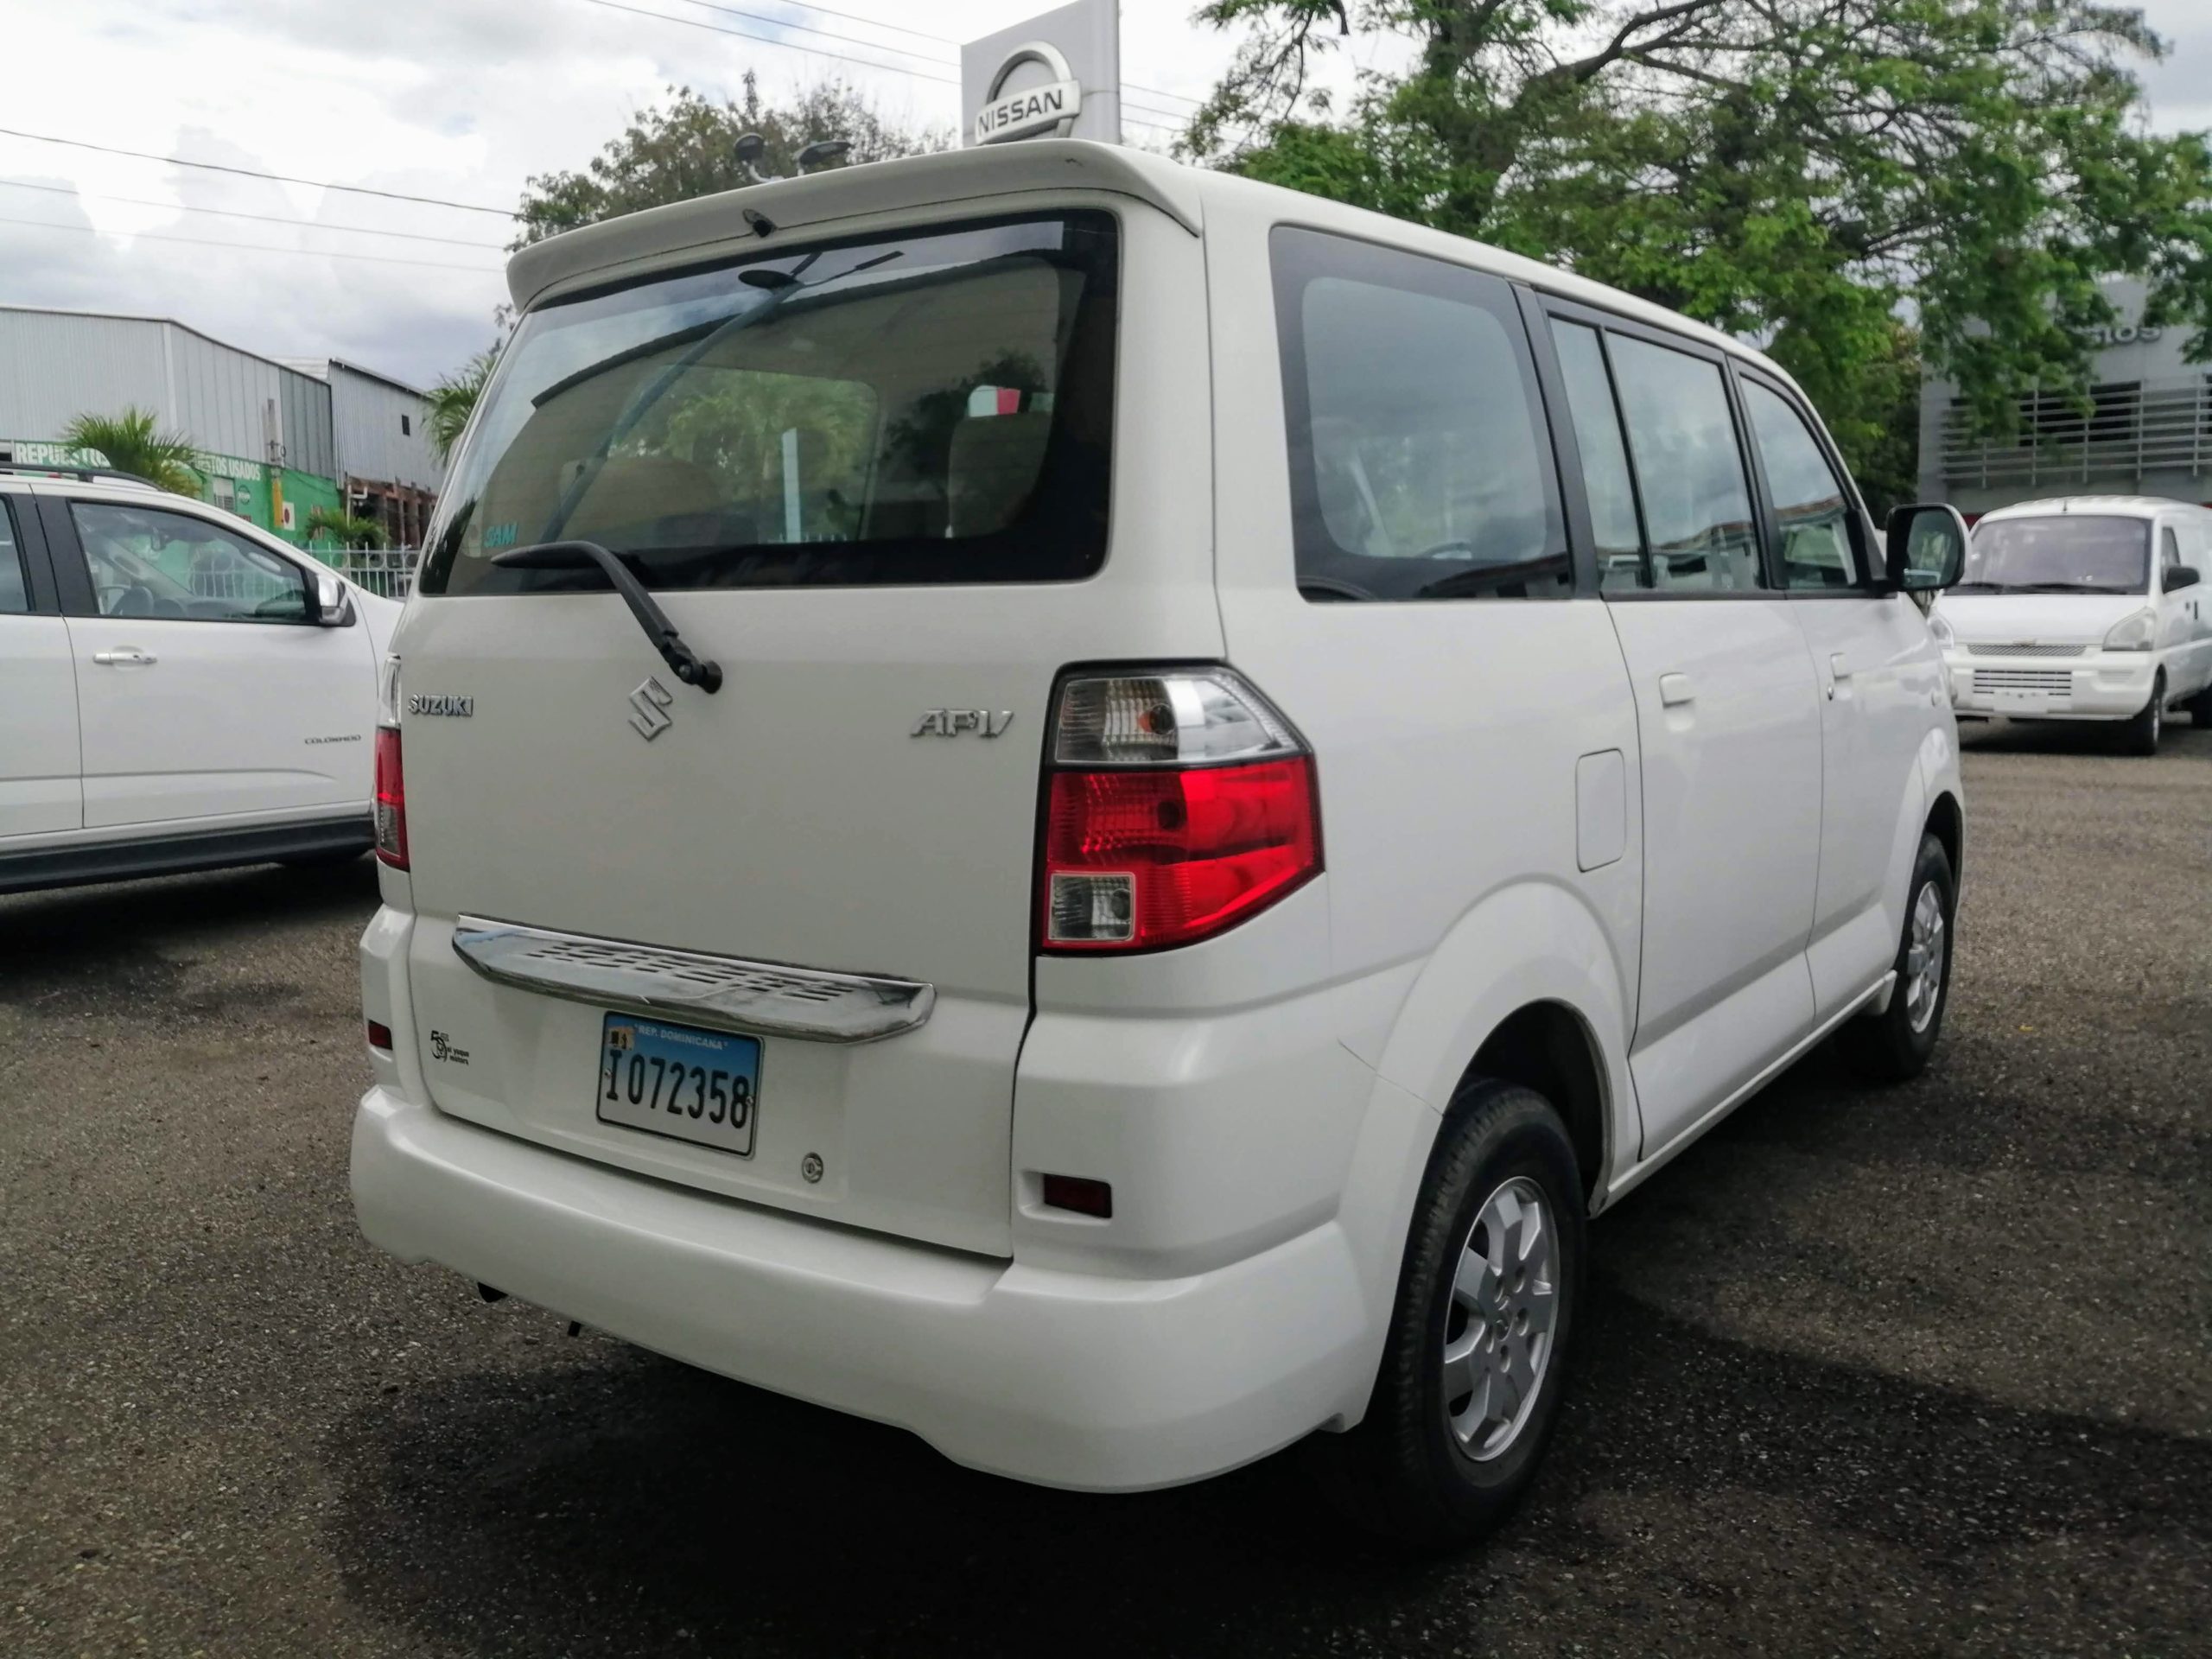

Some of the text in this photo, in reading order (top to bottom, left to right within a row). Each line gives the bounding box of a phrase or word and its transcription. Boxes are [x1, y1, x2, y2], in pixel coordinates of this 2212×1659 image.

[978, 89, 1063, 137] NISSAN
[228, 457, 261, 481] USADOS
[408, 694, 474, 717] SUZUKI
[910, 709, 1014, 739] APV
[607, 1049, 750, 1129] I072358
